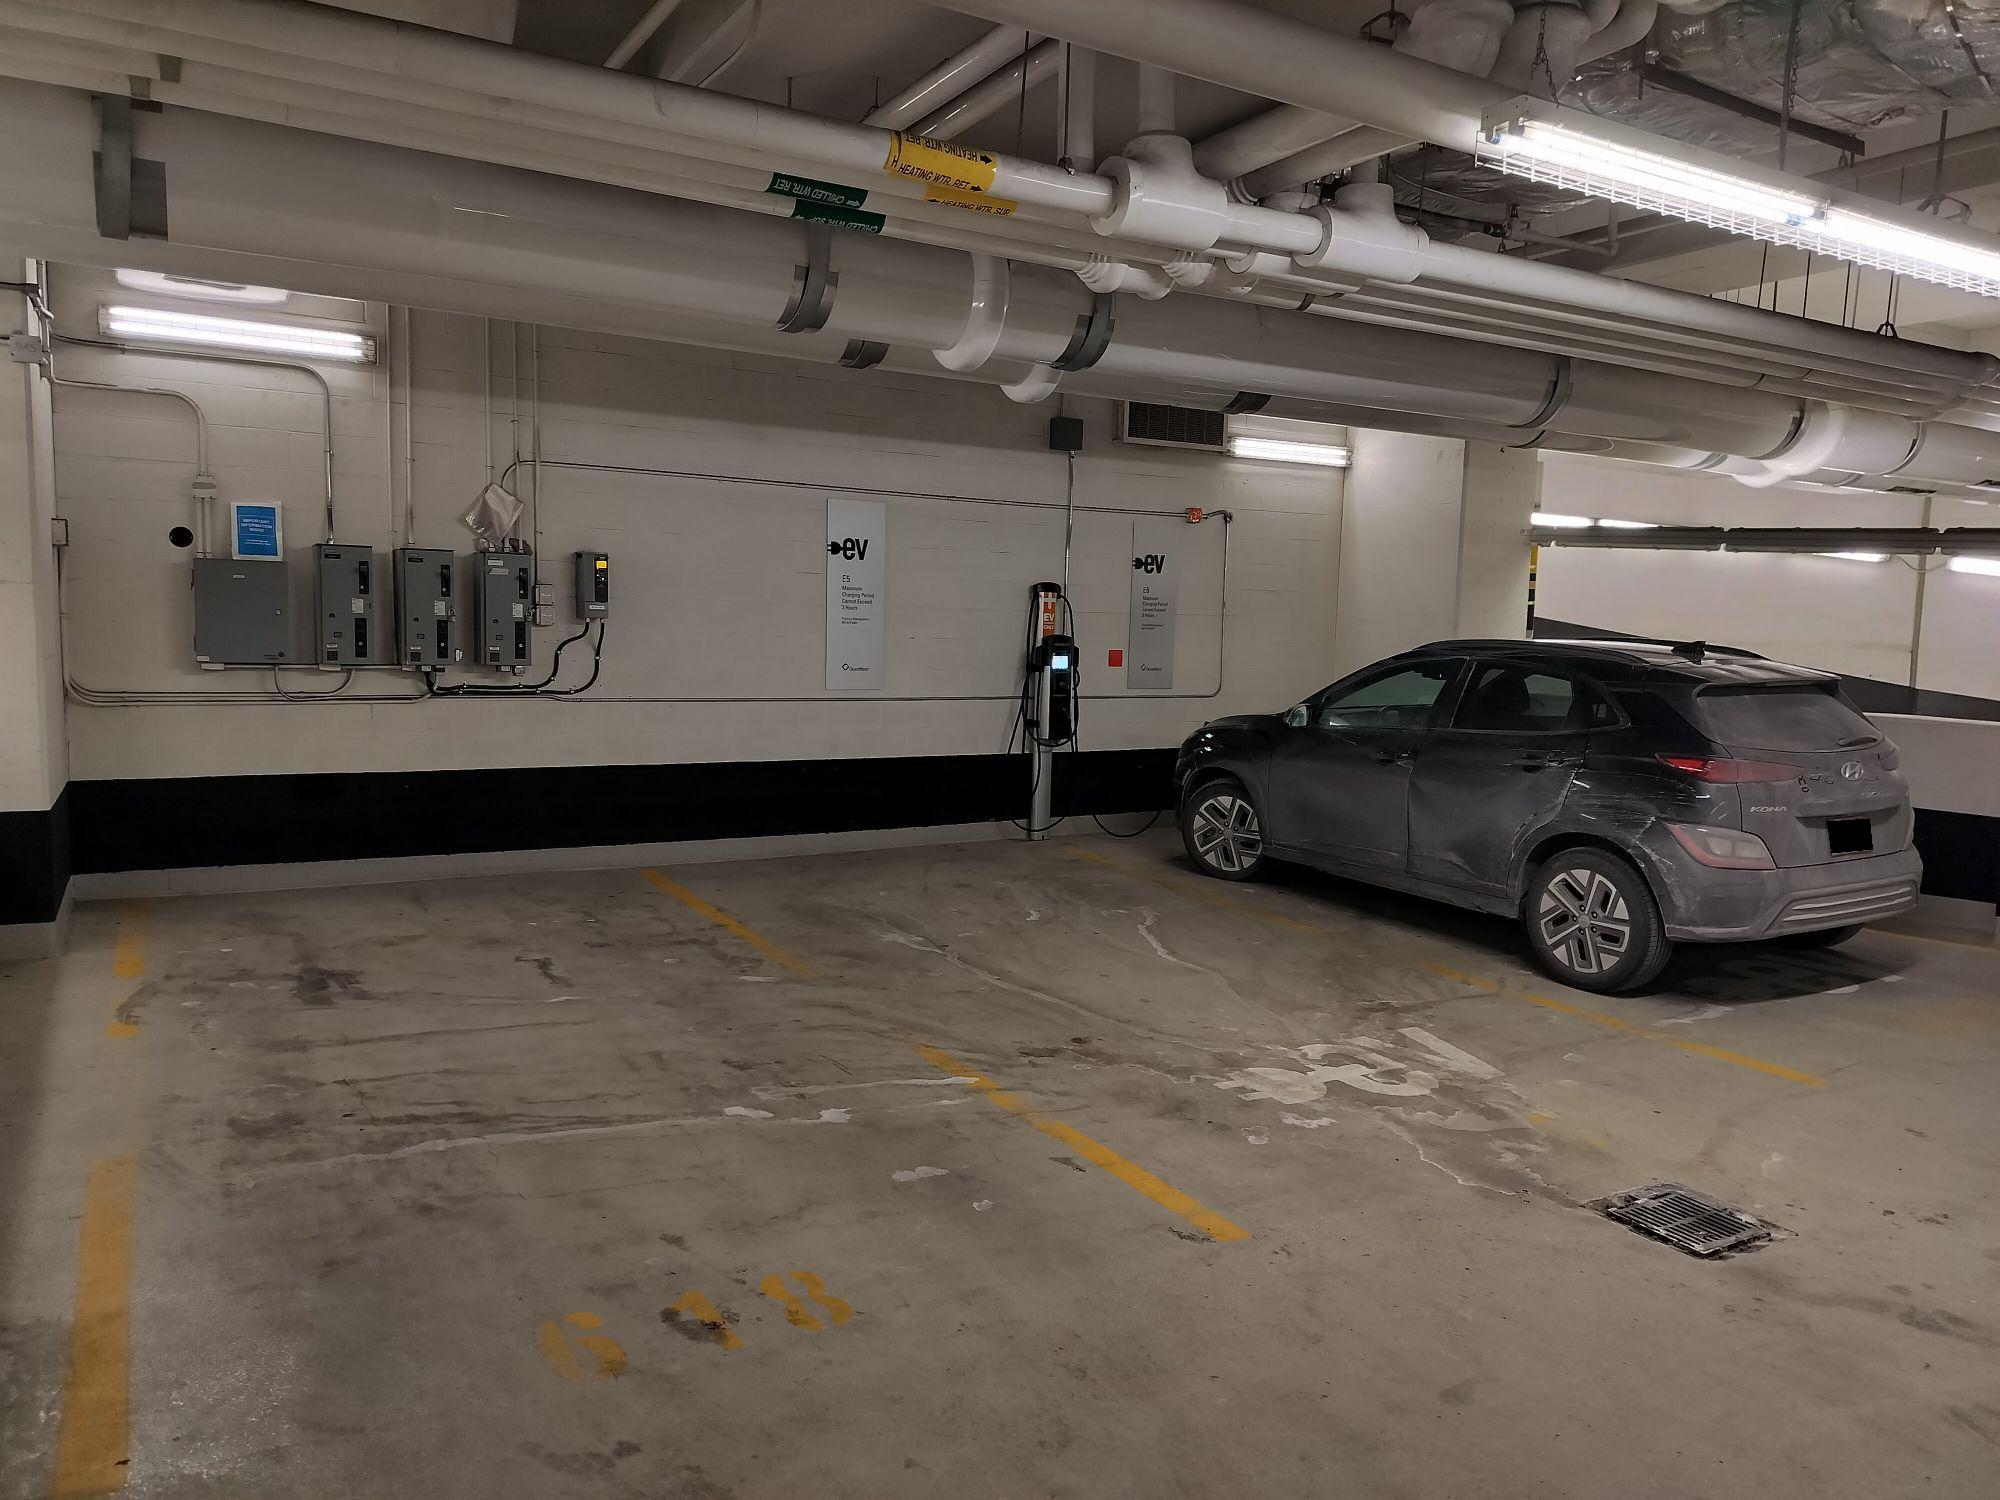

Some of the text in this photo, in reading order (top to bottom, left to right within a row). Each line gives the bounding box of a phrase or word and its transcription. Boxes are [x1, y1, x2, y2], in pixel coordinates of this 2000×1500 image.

[943, 145, 978, 162] HEATING
[898, 164, 933, 181] HEATING
[932, 173, 951, 187] WTR.
[774, 178, 845, 205] CHILLED WTR. RET
[845, 220, 878, 233] CHILLED
[842, 537, 869, 561] ev
[1143, 554, 1165, 574] ev
[842, 575, 851, 583] E5
[1044, 613, 1055, 621] EV
